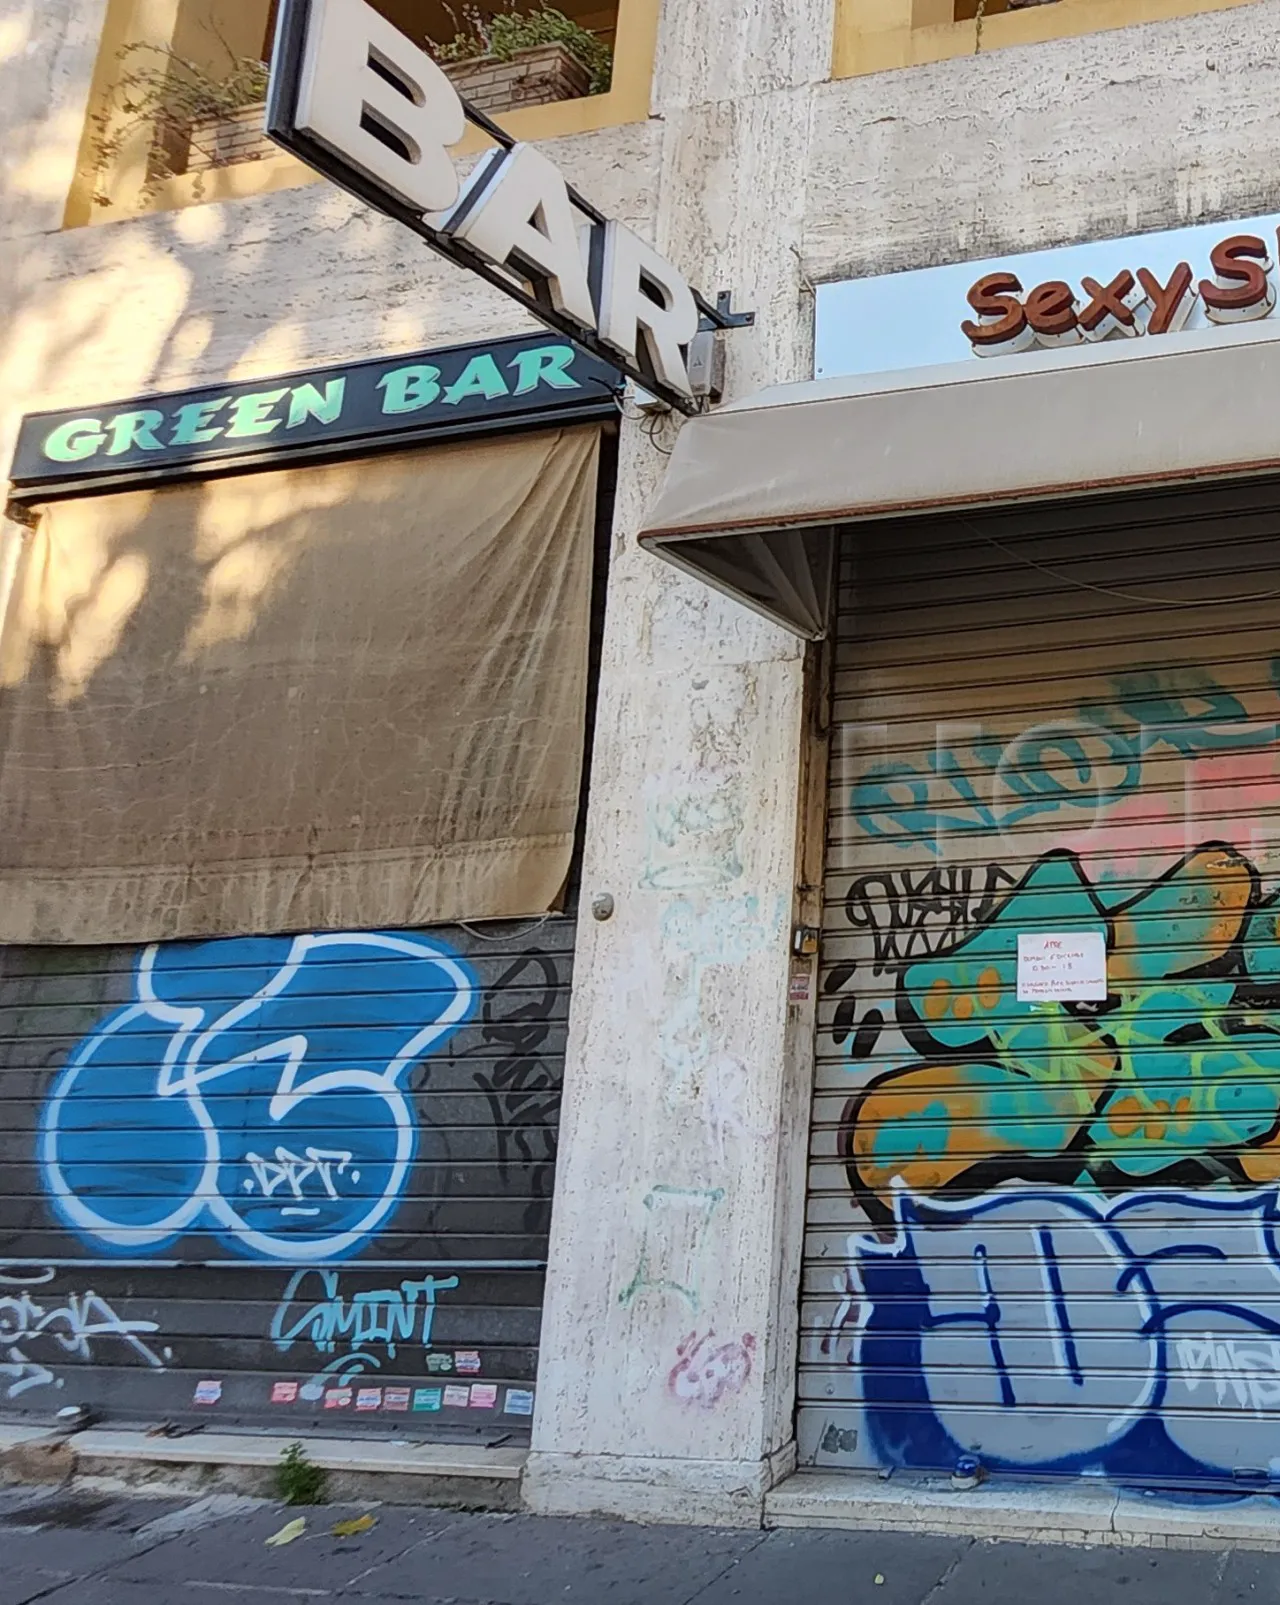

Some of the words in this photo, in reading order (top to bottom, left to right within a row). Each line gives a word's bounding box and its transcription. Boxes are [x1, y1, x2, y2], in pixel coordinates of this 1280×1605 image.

[295, 0, 698, 402] BAR
[961, 260, 1195, 348] Sexy
[43, 377, 347, 463] GREEN
[375, 344, 583, 416] BAR
